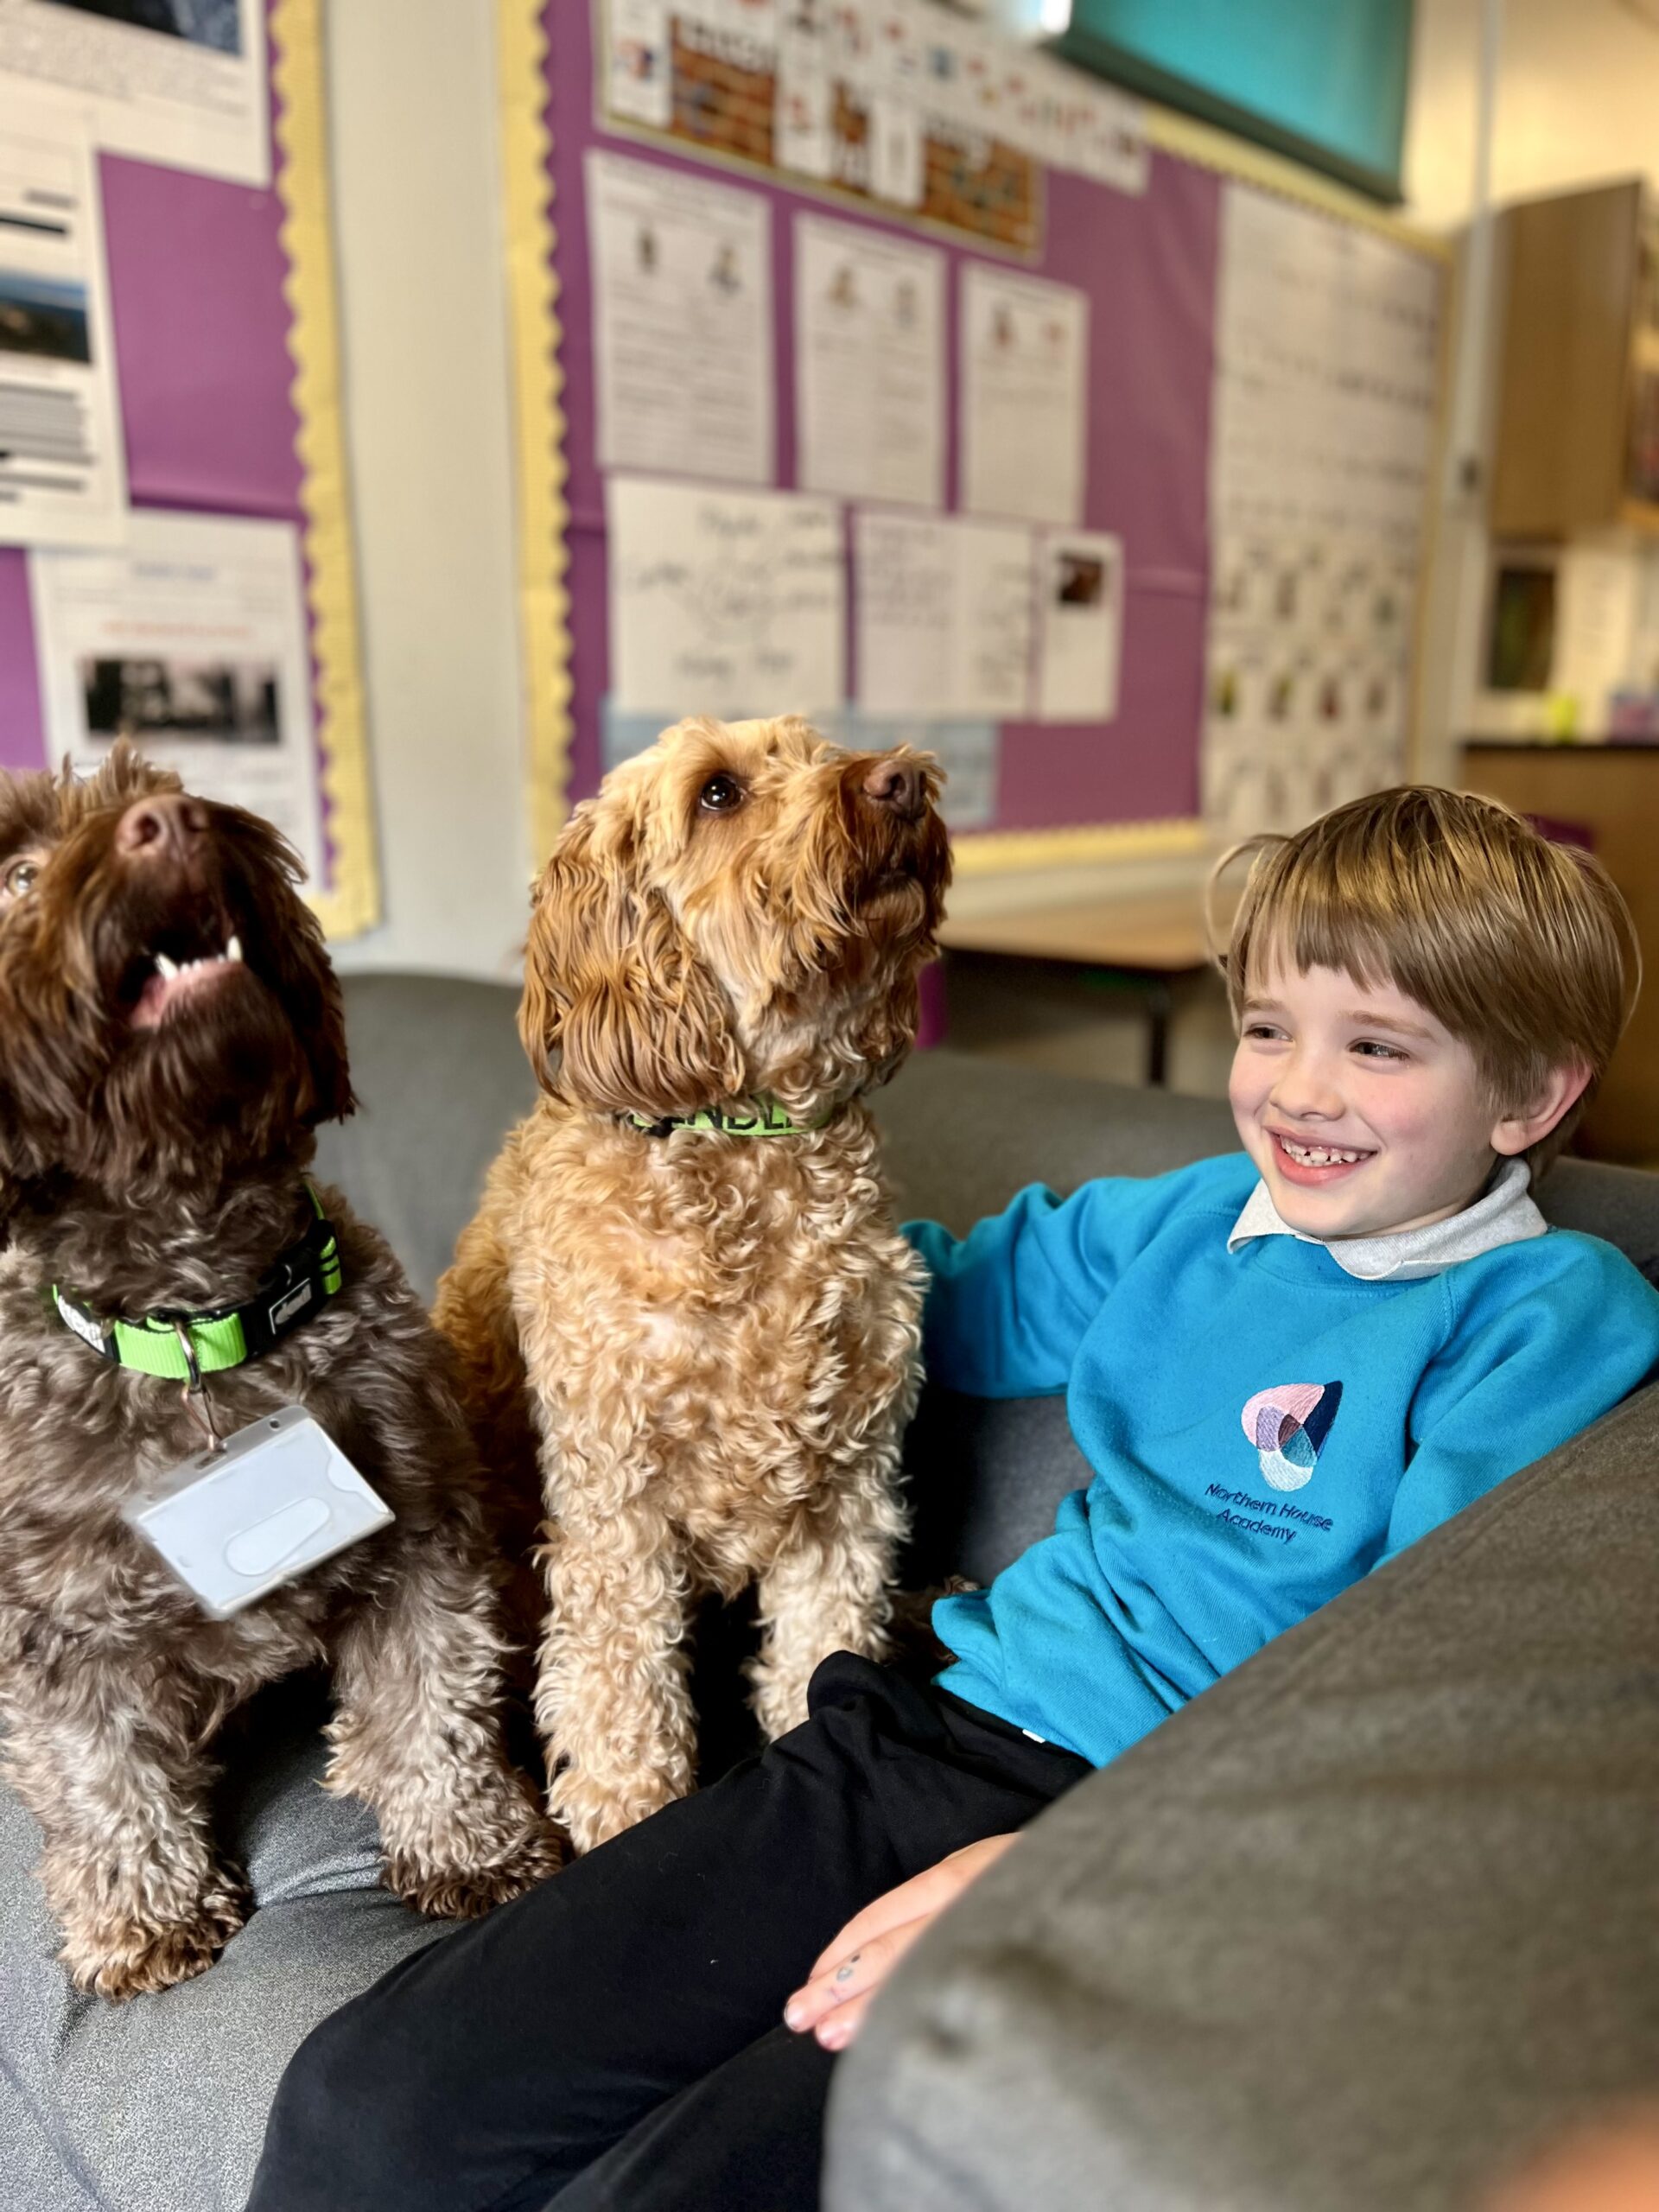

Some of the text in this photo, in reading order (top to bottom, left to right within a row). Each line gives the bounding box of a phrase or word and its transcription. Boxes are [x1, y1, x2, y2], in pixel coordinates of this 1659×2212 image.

[1205, 1484, 1333, 1532] Northern House
[1217, 1509, 1297, 1544] Academy
